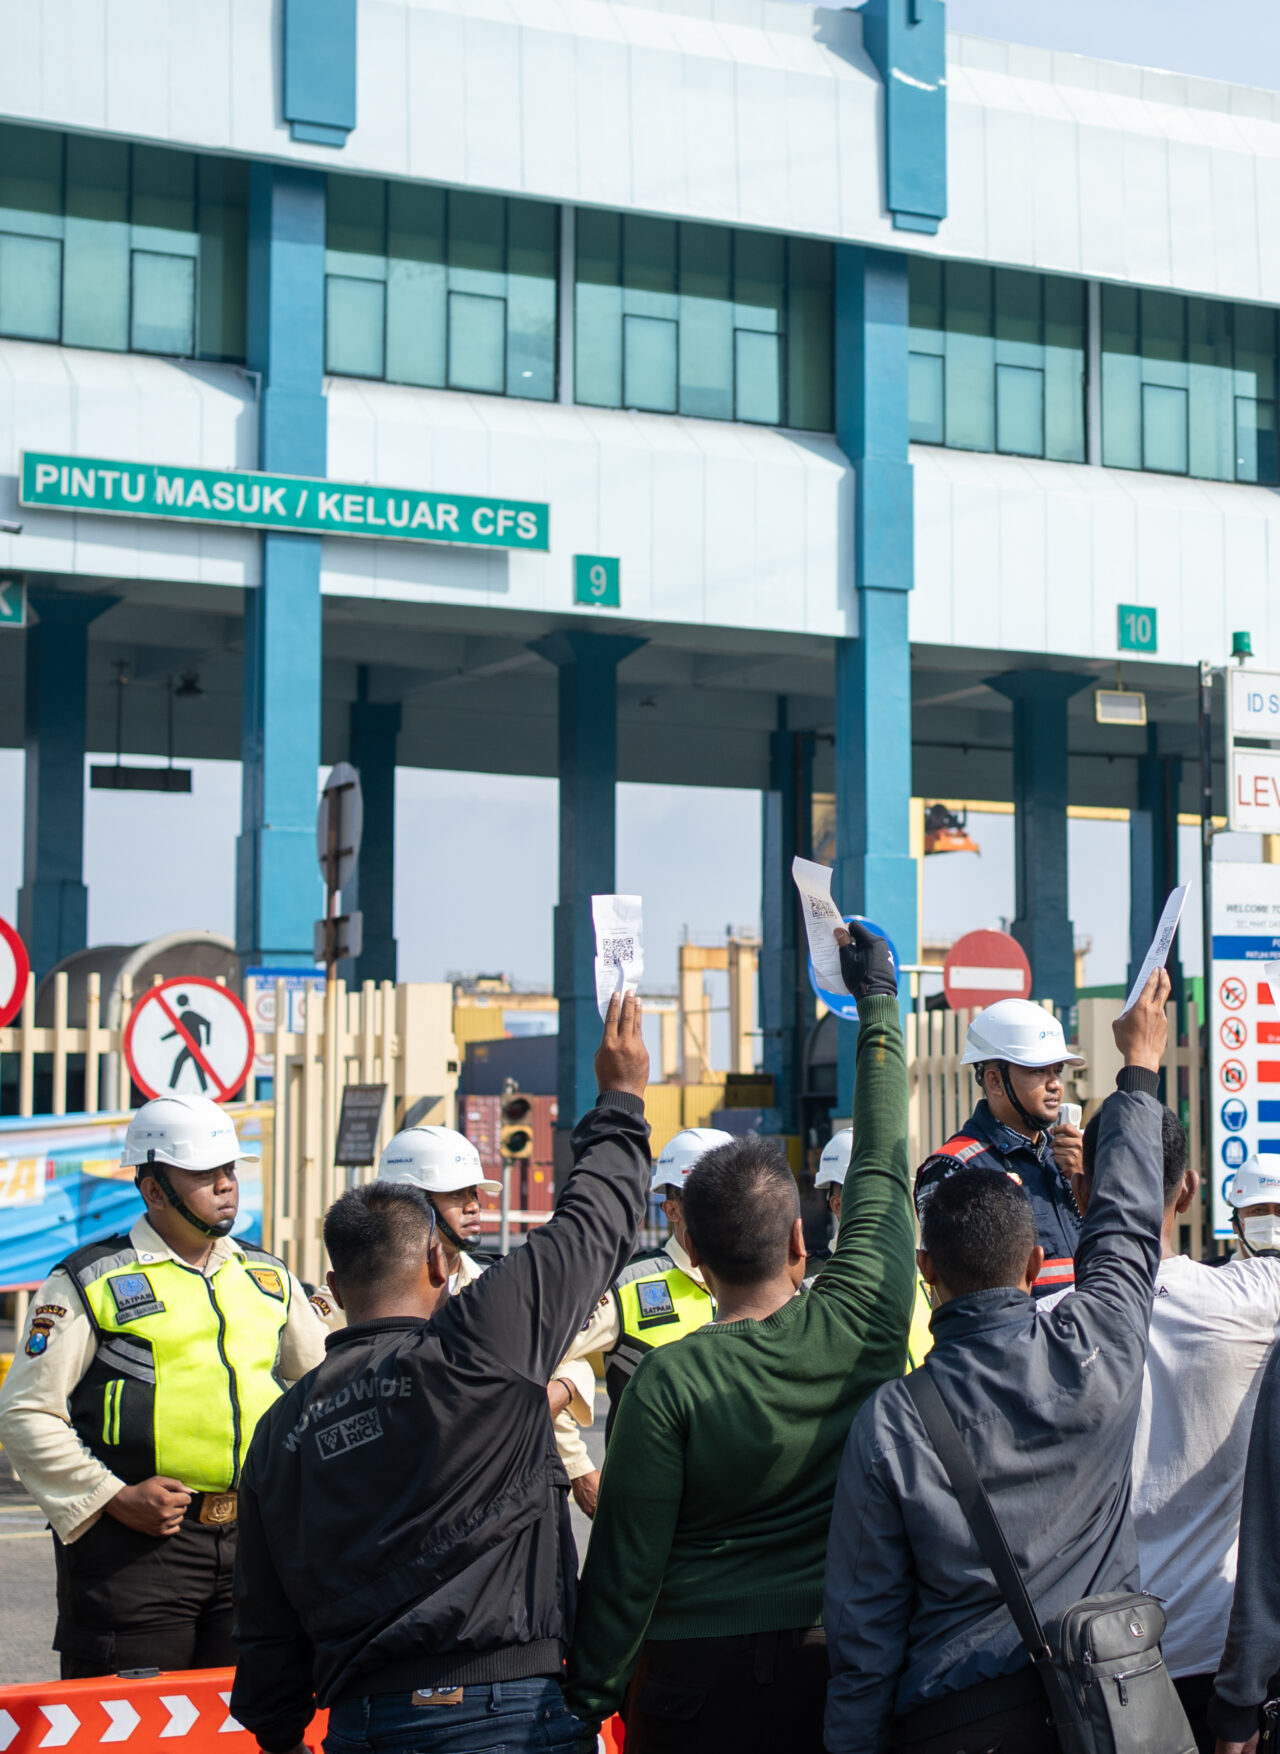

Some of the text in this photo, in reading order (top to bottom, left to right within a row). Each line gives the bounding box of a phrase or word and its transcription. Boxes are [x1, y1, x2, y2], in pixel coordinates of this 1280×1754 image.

[35, 463, 146, 503] PINTU
[155, 474, 287, 518] MASUK
[318, 491, 460, 533] KELUAR
[471, 506, 538, 540] CFS
[589, 564, 607, 597] 9
[1124, 613, 1152, 645] 10
[1247, 692, 1264, 713] ID
[1226, 903, 1268, 914] WELCOME
[118, 1293, 153, 1308] SATPAM
[643, 1306, 672, 1316] SATPAM
[282, 1376, 413, 1453] WORLDWIDE
[343, 1410, 379, 1433] WOLF
[345, 1424, 382, 1446] RICK
